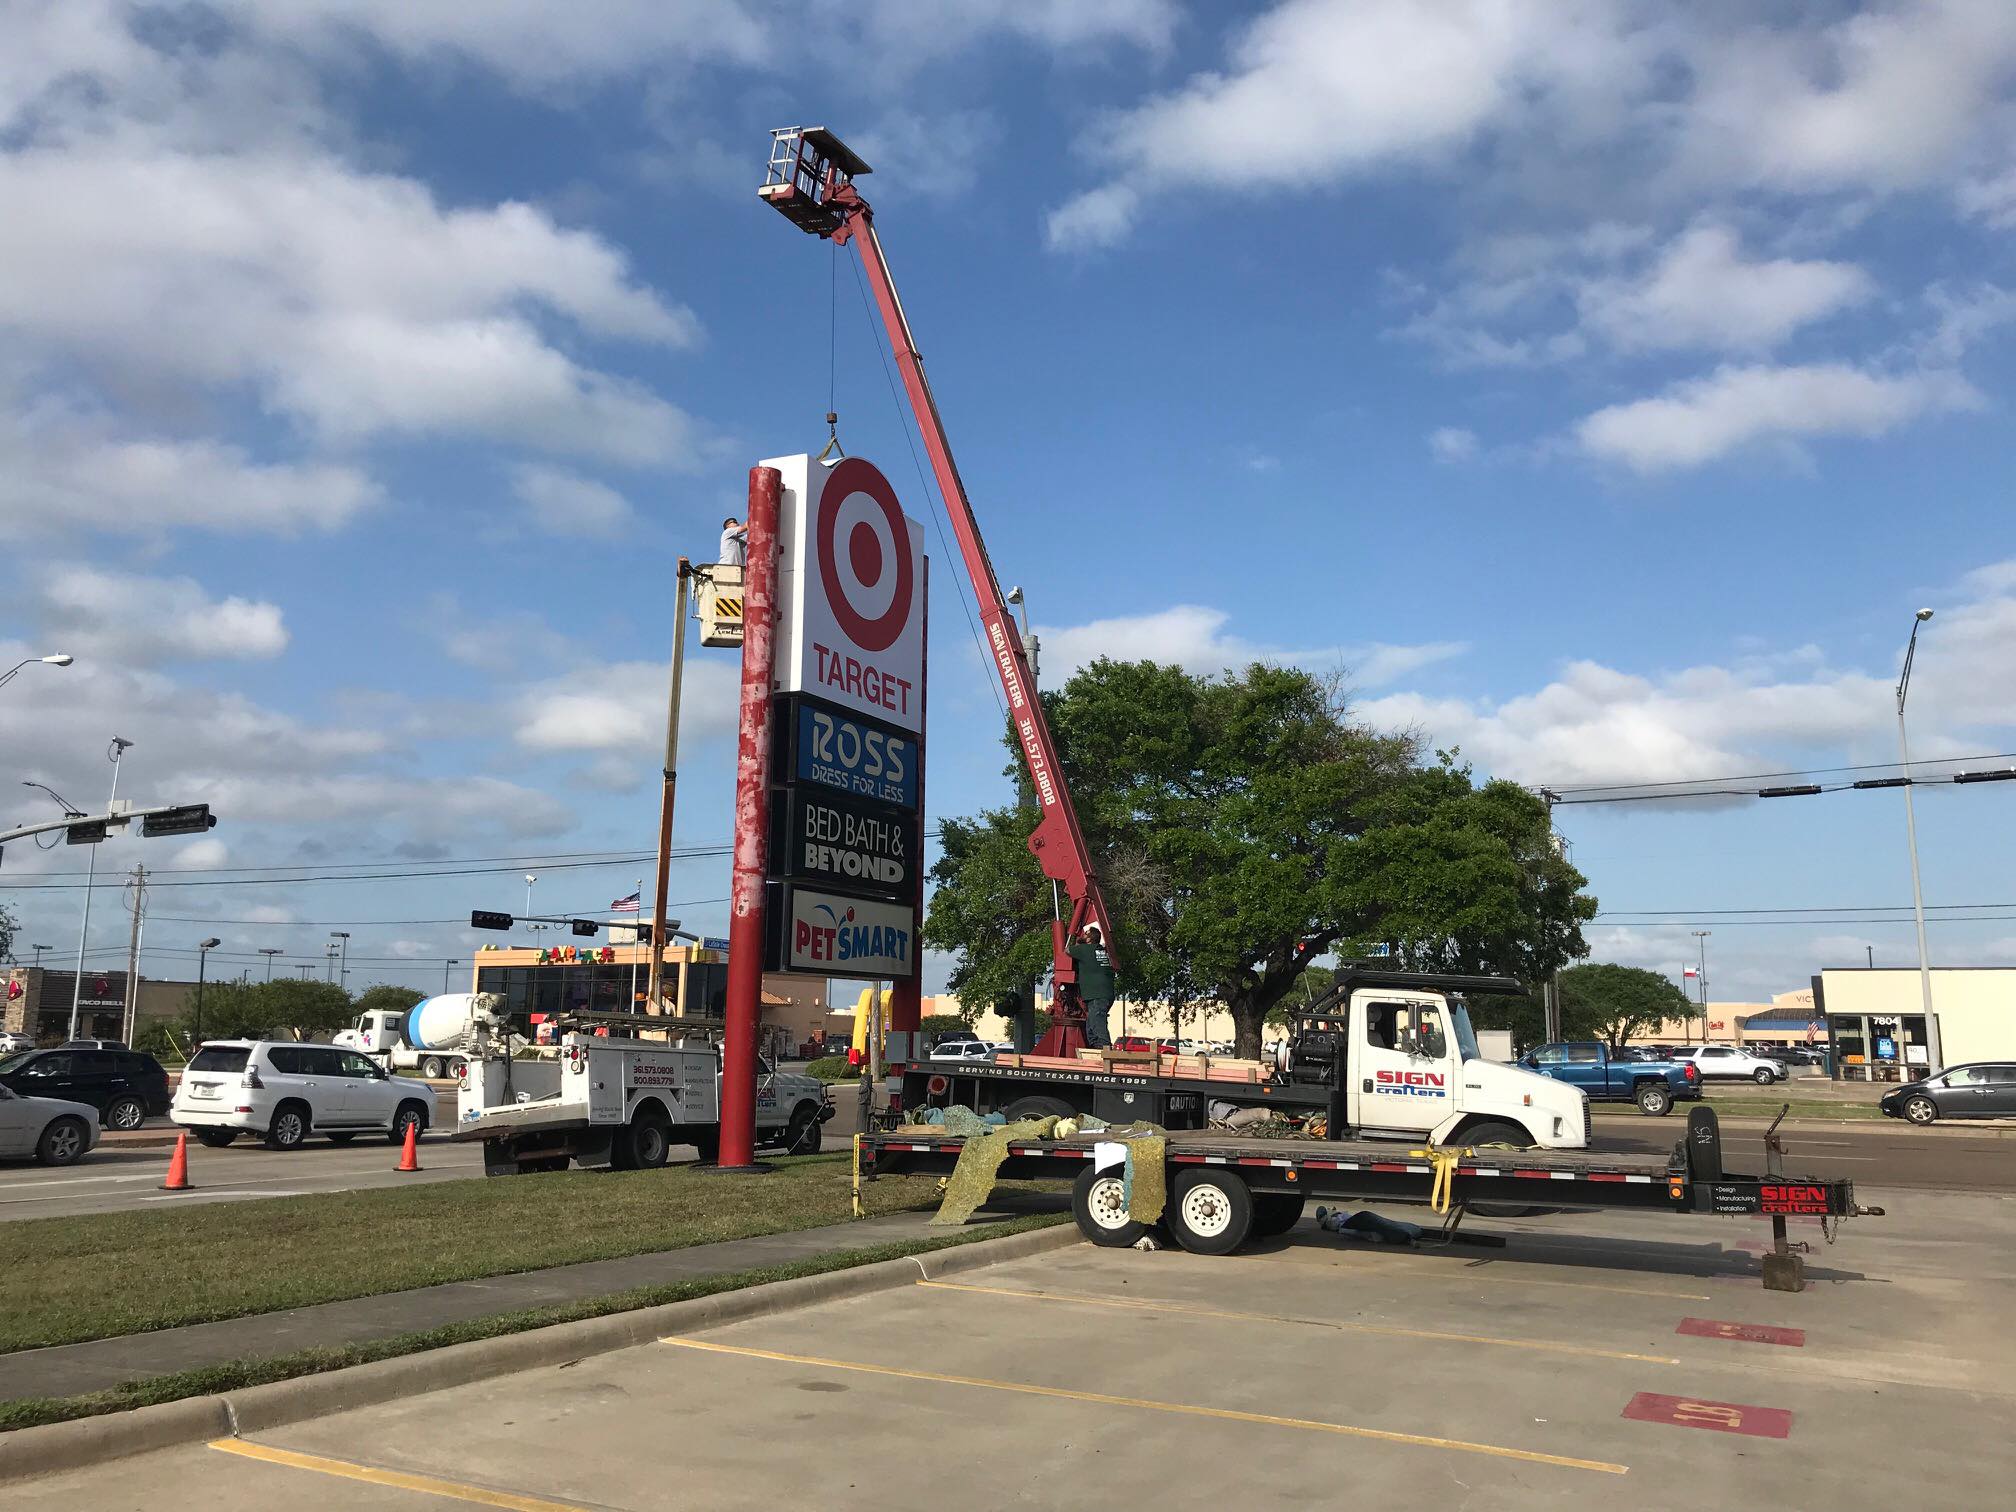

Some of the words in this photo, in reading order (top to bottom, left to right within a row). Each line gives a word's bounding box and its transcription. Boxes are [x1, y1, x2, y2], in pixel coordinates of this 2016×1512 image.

[813, 642, 912, 715] TARGET
[989, 622, 1006, 650] SIGN
[998, 650, 1025, 709] CRAFTERS
[812, 712, 905, 783] ROSS
[1019, 717, 1056, 806] 361.573.0808
[811, 763, 849, 790] DRESS
[852, 775, 875, 796] FOR
[878, 782, 904, 803] LESS
[805, 803, 841, 842] BED
[845, 814, 888, 854] BATH
[891, 825, 904, 857] &
[804, 843, 905, 883] BEYOND
[796, 919, 908, 961] PETSMART
[1873, 1016, 1899, 1026] 7804
[633, 1065, 674, 1074] 361.573.0808
[958, 1066, 1002, 1075] SERVING
[1006, 1069, 1041, 1078] SOUTH
[1045, 1072, 1080, 1081] TEXAS
[1376, 1070, 1445, 1086] SIGN
[1376, 1085, 1446, 1097] crafters
[1761, 1186, 1826, 1201] SIGN
[1761, 1202, 1828, 1213] crafters
